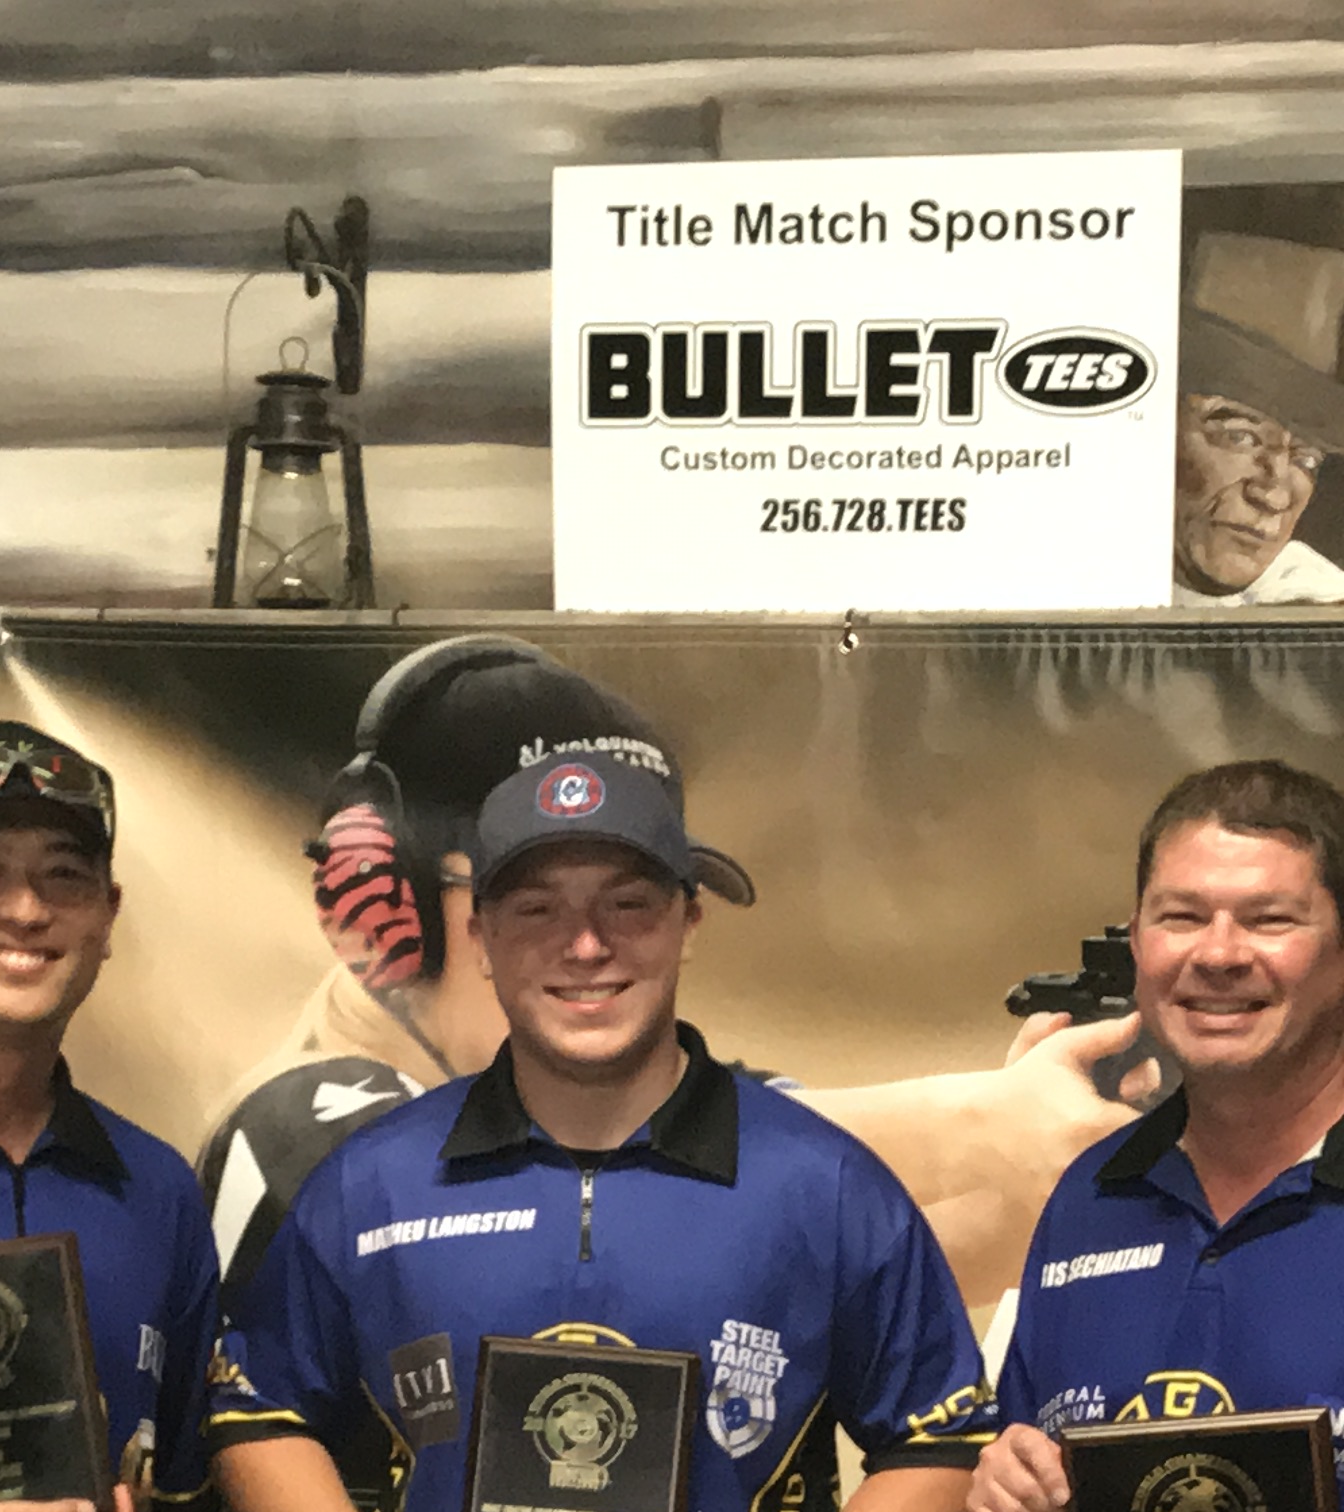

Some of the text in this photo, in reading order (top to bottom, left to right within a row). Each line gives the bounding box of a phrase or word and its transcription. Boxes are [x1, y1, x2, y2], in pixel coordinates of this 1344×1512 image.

[607, 198, 1134, 251] Title Match Sponsor
[584, 322, 1003, 424] BULLET
[1022, 350, 1133, 392] TEES
[660, 442, 1071, 474] Custom Decorated Apparel
[760, 498, 968, 533] 256.728.TEES
[722, 1319, 782, 1354] STEEL
[710, 1340, 789, 1379] TARGET
[713, 1365, 777, 1398] PAINT
